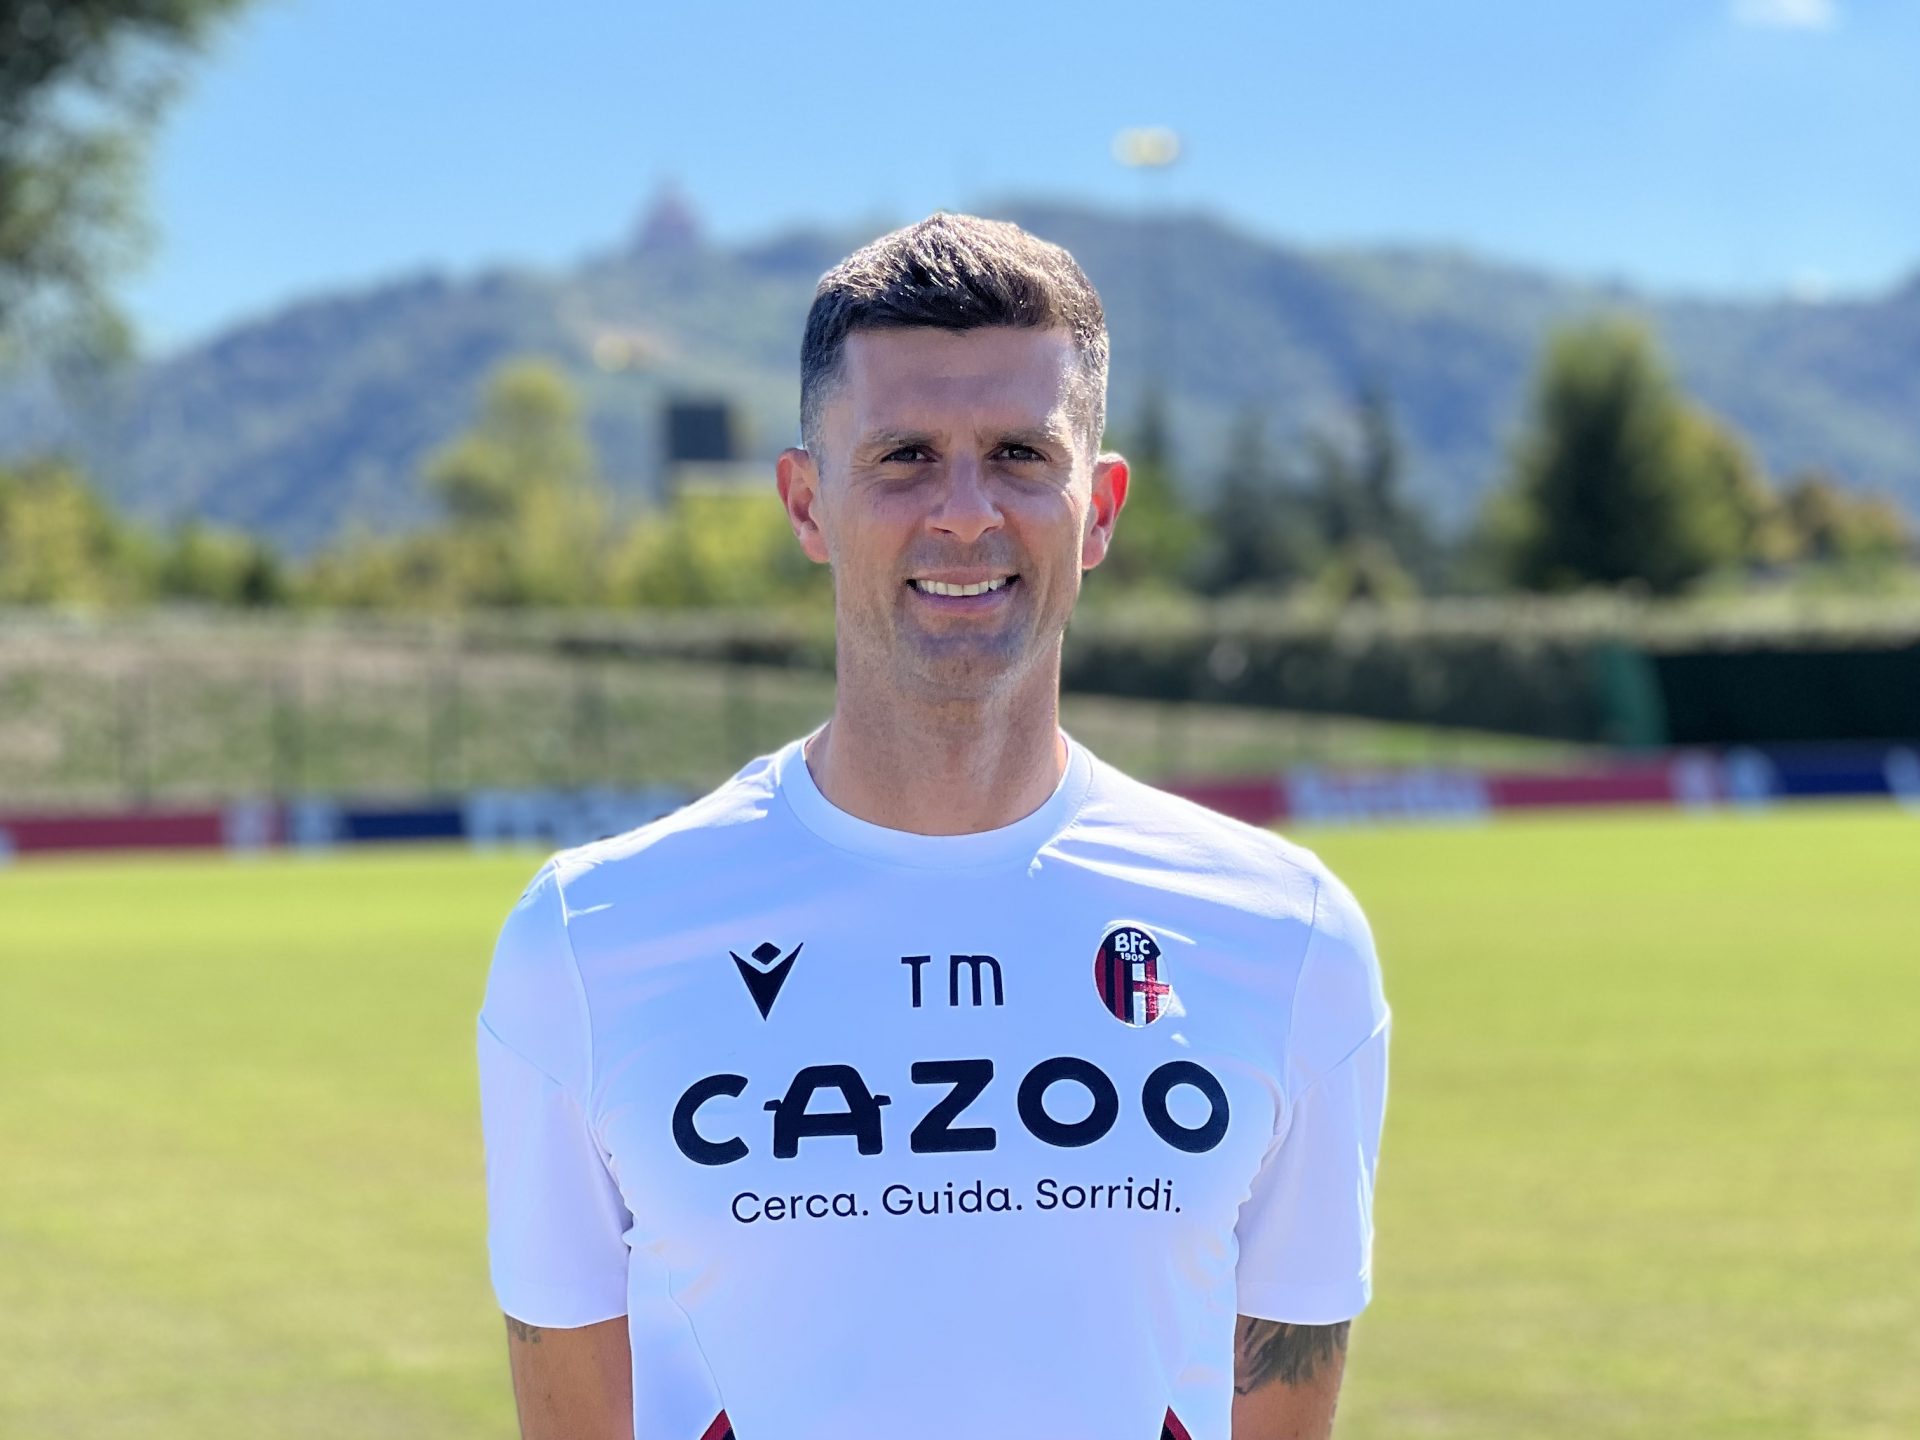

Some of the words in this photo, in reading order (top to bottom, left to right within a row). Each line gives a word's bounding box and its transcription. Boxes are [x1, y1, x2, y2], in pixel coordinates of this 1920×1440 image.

[1114, 931, 1151, 955] BFC
[1120, 952, 1145, 962] 1909
[673, 1057, 1229, 1165] CAZOO
[732, 1193, 868, 1223] Cerca.
[883, 1180, 1022, 1215] Guida.
[1036, 1177, 1180, 1213] Sorridi.
